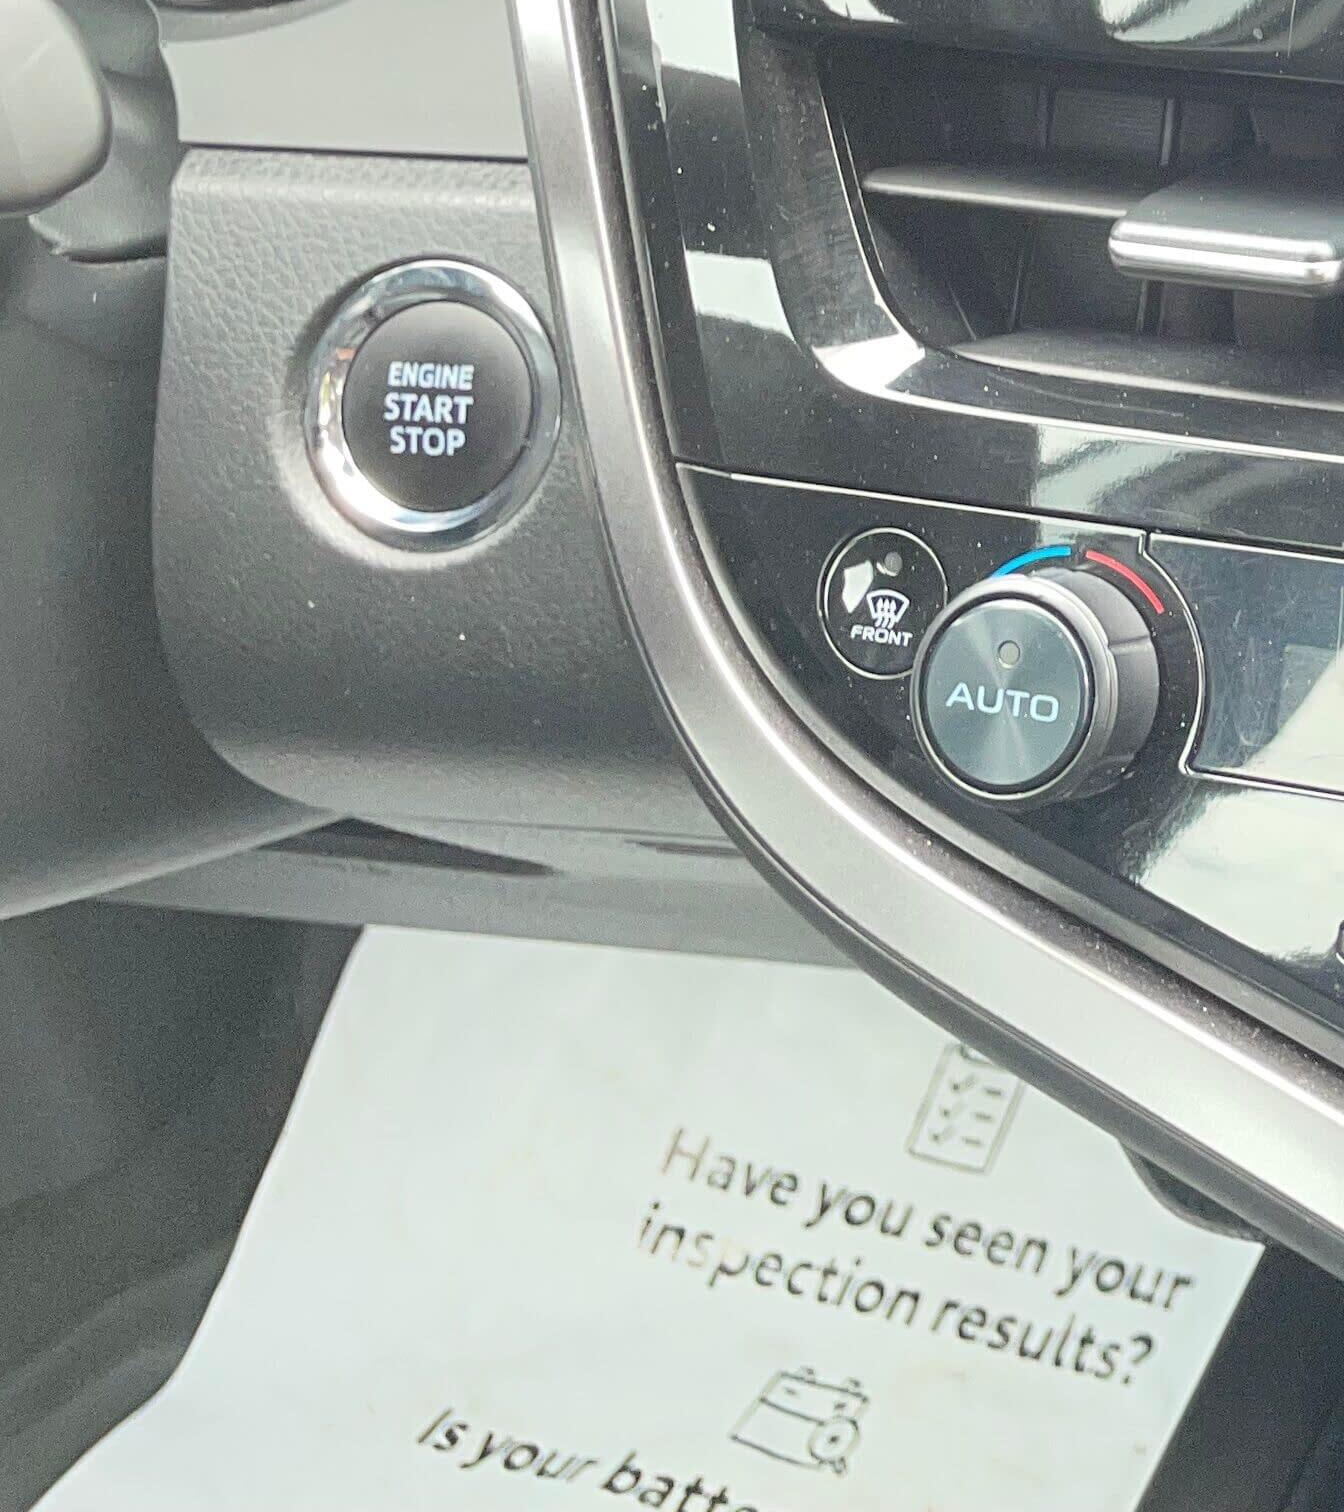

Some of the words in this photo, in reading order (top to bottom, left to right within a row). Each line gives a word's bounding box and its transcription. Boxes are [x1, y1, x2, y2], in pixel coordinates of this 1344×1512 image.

[387, 361, 475, 390] ENGINE
[384, 393, 473, 424] START
[389, 426, 466, 456] STOP
[850, 624, 913, 648] FRONT
[946, 682, 1059, 723] AUTO
[662, 1128, 800, 1207] Have
[804, 1182, 915, 1239] you
[924, 1211, 1050, 1274] seen
[1054, 1245, 1195, 1311] your
[637, 1199, 921, 1326] inspection
[931, 1295, 1156, 1385] results?
[417, 1407, 469, 1451] Is
[460, 1431, 599, 1481] your
[603, 1449, 758, 1512] batt
